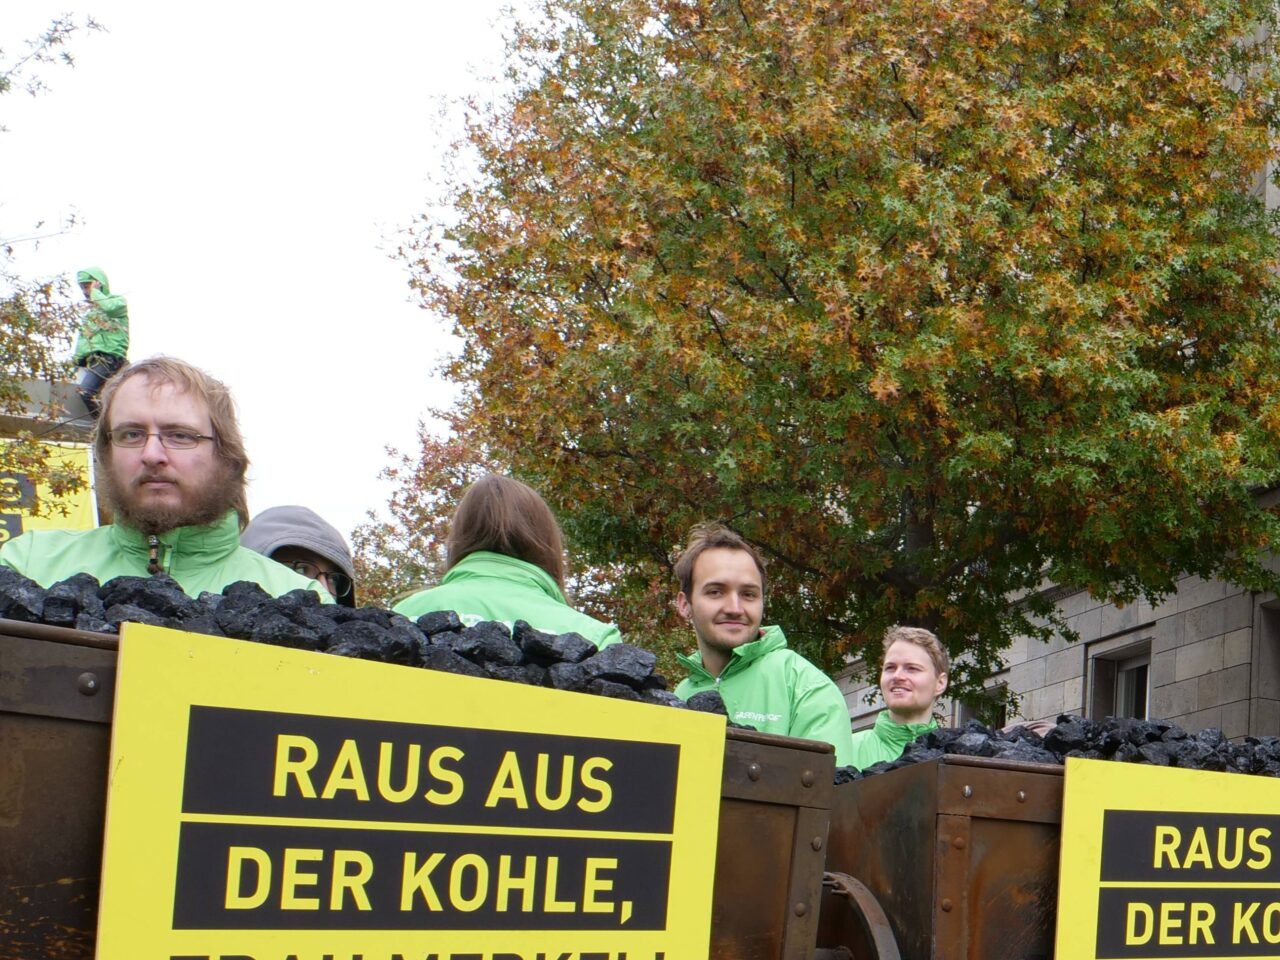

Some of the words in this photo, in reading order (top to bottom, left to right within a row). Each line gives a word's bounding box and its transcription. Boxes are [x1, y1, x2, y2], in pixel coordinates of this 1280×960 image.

[272, 734, 464, 806] RAUS
[485, 751, 613, 813] AUS
[1153, 825, 1272, 870] RAUS
[224, 846, 374, 911] DER
[400, 852, 633, 925] KOHLE,
[1125, 902, 1215, 945] DER
